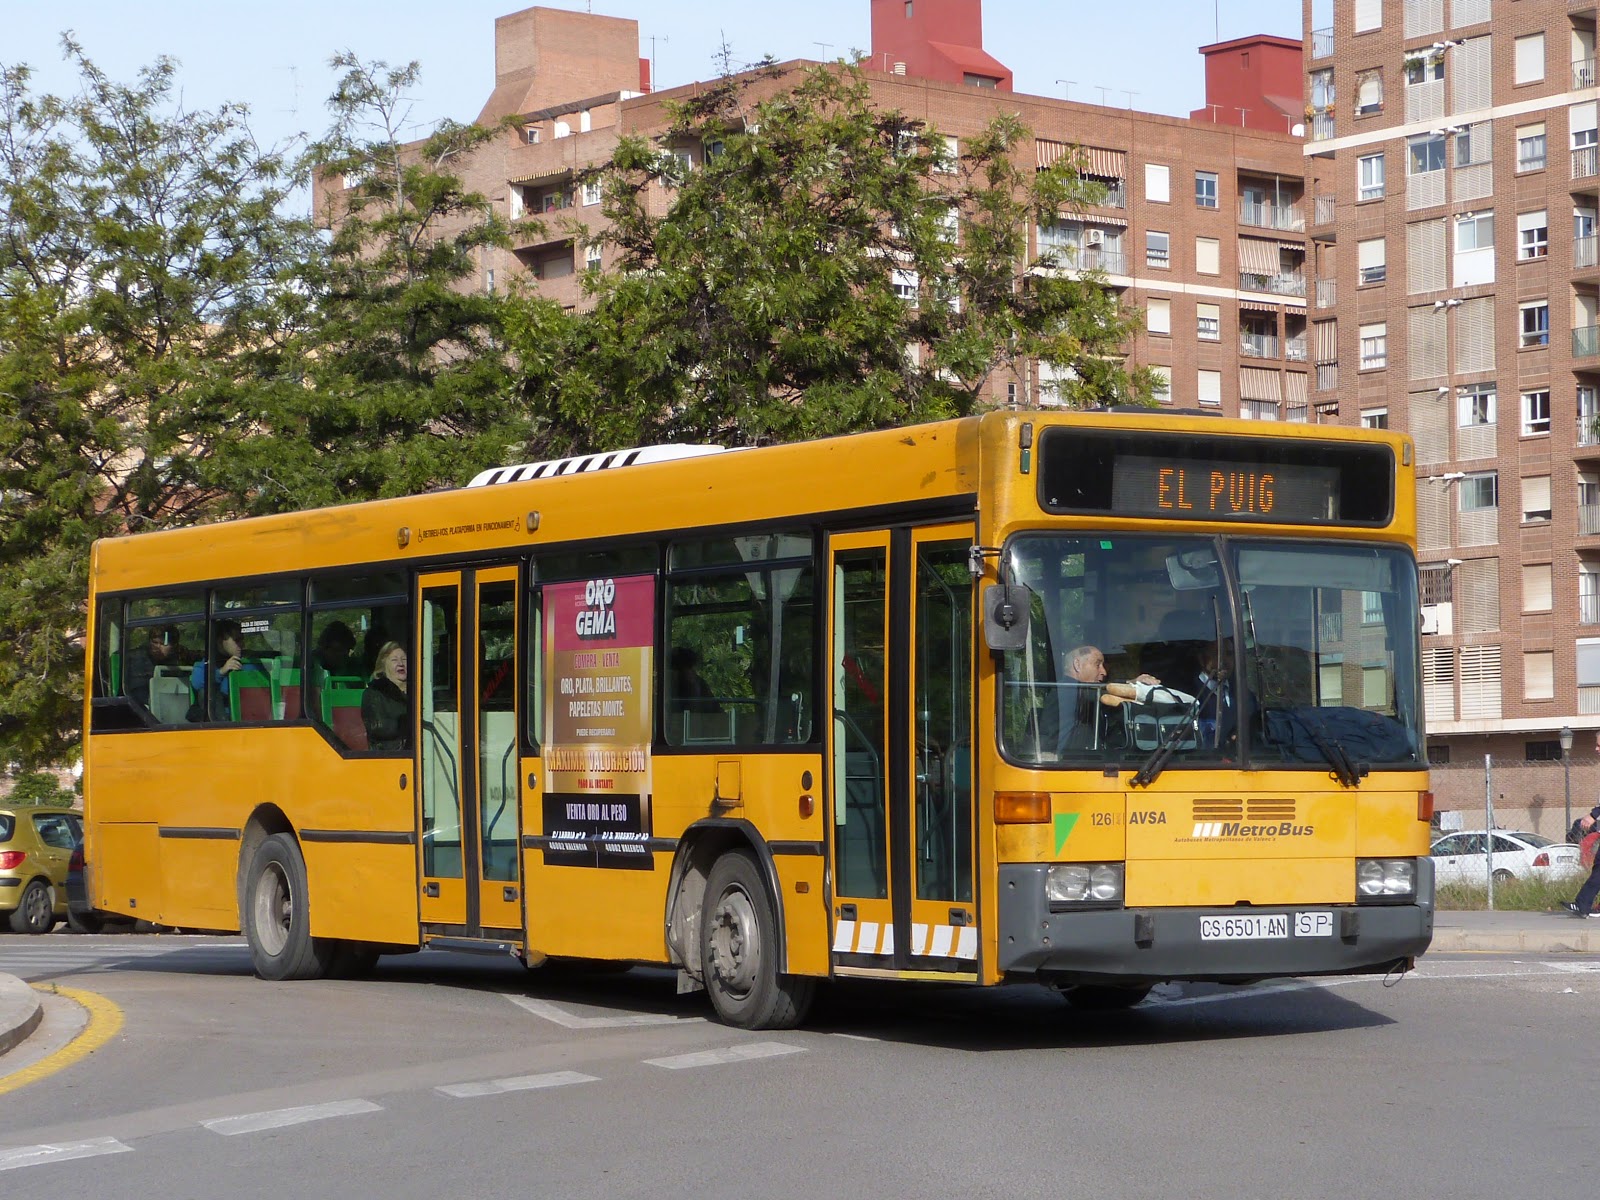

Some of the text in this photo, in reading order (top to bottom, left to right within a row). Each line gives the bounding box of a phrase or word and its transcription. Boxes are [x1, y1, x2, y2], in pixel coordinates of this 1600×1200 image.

[1159, 468, 1274, 512] EL PUIG
[450, 524, 474, 534] PLATAFORMA
[476, 524, 482, 532] EN
[484, 520, 514, 530] FUNCIONAMENT
[586, 578, 615, 610] ORO
[576, 610, 616, 635] GEMA
[575, 654, 597, 669] COMPRA
[602, 652, 619, 668] VENTA
[560, 676, 632, 696] ORO, PLATA, BRILLANTES,
[570, 700, 624, 717] PAPELETAS MONTE.
[548, 746, 645, 772] MÁXIMA VALORACIÓN
[566, 804, 627, 821] VENTA ORO AL PESO
[1091, 811, 1166, 826] 126 AVSA
[1221, 822, 1314, 836] MetroBus
